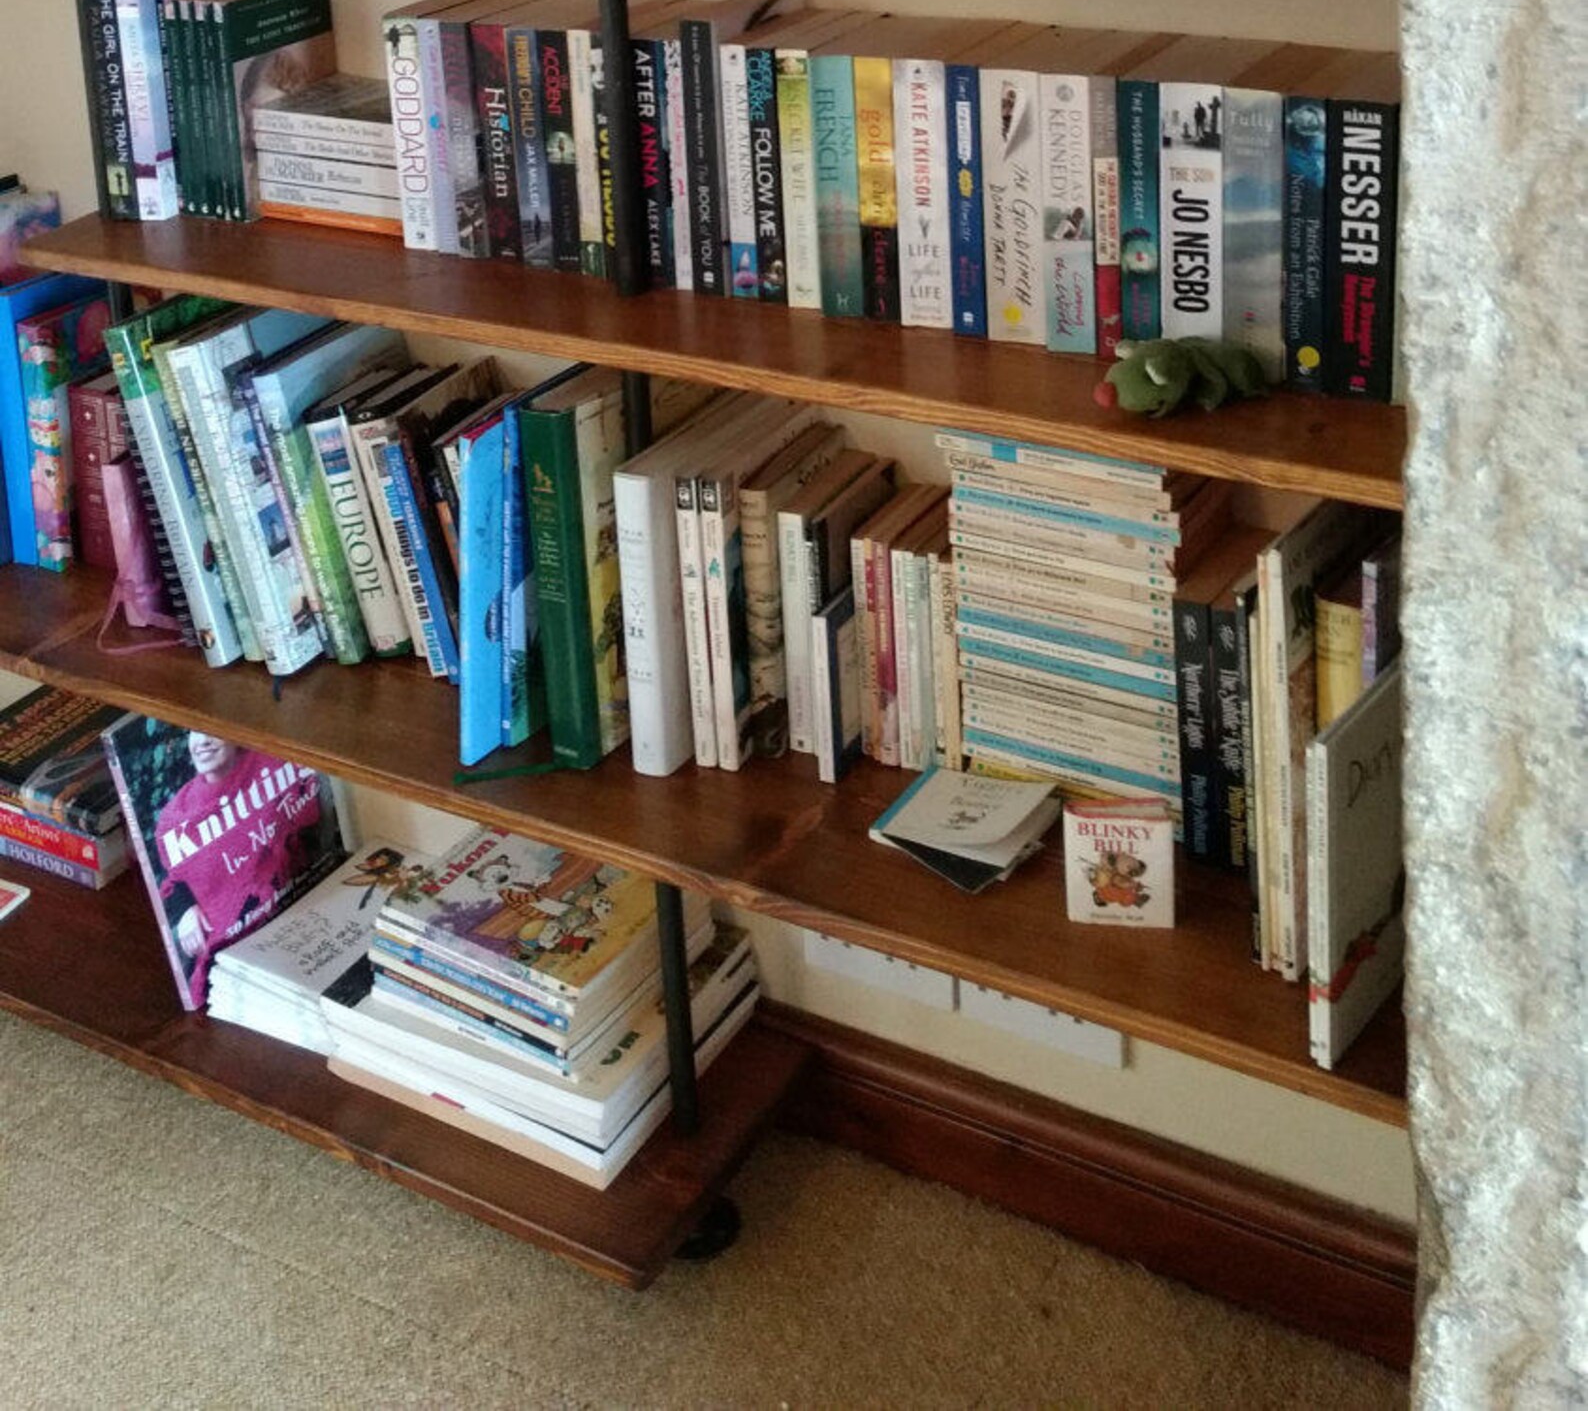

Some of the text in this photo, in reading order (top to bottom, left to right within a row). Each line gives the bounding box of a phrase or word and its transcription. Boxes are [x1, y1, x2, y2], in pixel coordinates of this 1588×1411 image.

[103, 25, 118, 57] GIRL
[107, 63, 121, 85] ON
[543, 45, 563, 116] ACCIDENT
[747, 56, 765, 122] CLARKE
[110, 89, 125, 117] THE
[392, 57, 428, 194] GODDARD
[1229, 109, 1276, 133] Tully
[114, 122, 129, 163] TRAIN
[484, 87, 510, 199] Historian
[518, 88, 541, 209] CHILD JAX MILLER
[634, 49, 661, 267] AFTER ANNA ALEX LAKE
[735, 83, 753, 217] KATE ATKINSON
[815, 89, 839, 182] FRENCH
[859, 107, 892, 164] gold
[910, 82, 932, 207] KATE ATKINSON
[1049, 108, 1068, 202] KENNEDY
[1069, 110, 1086, 203] DOUGLAS
[1131, 91, 1145, 220] THE HUSBAND'S SECRET
[698, 185, 711, 223] BOOK
[753, 127, 777, 238] FOLLOW ME
[1341, 125, 1382, 266] NESSER
[700, 239, 714, 267] YOU
[908, 243, 942, 259] LIFE
[989, 183, 1007, 287] DONNA TARTT
[1172, 188, 1210, 314] JO NESBO
[1289, 173, 1306, 340] Notes from an Exhibition
[1305, 218, 1321, 299] Patrick Gale
[910, 286, 943, 301] LIFE
[1359, 275, 1377, 298] The
[178, 433, 195, 454] IN
[266, 406, 284, 431] The
[274, 432, 295, 465] most
[309, 555, 324, 570] to
[329, 477, 385, 603] EUROPE
[394, 519, 416, 568] things
[406, 567, 420, 584] to
[412, 584, 426, 605] do
[417, 605, 432, 621] in
[222, 779, 321, 875] In No Time
[1076, 822, 1154, 841] BLINKY
[1093, 838, 1139, 856] BILL
[8, 844, 75, 878] HOLFORD
